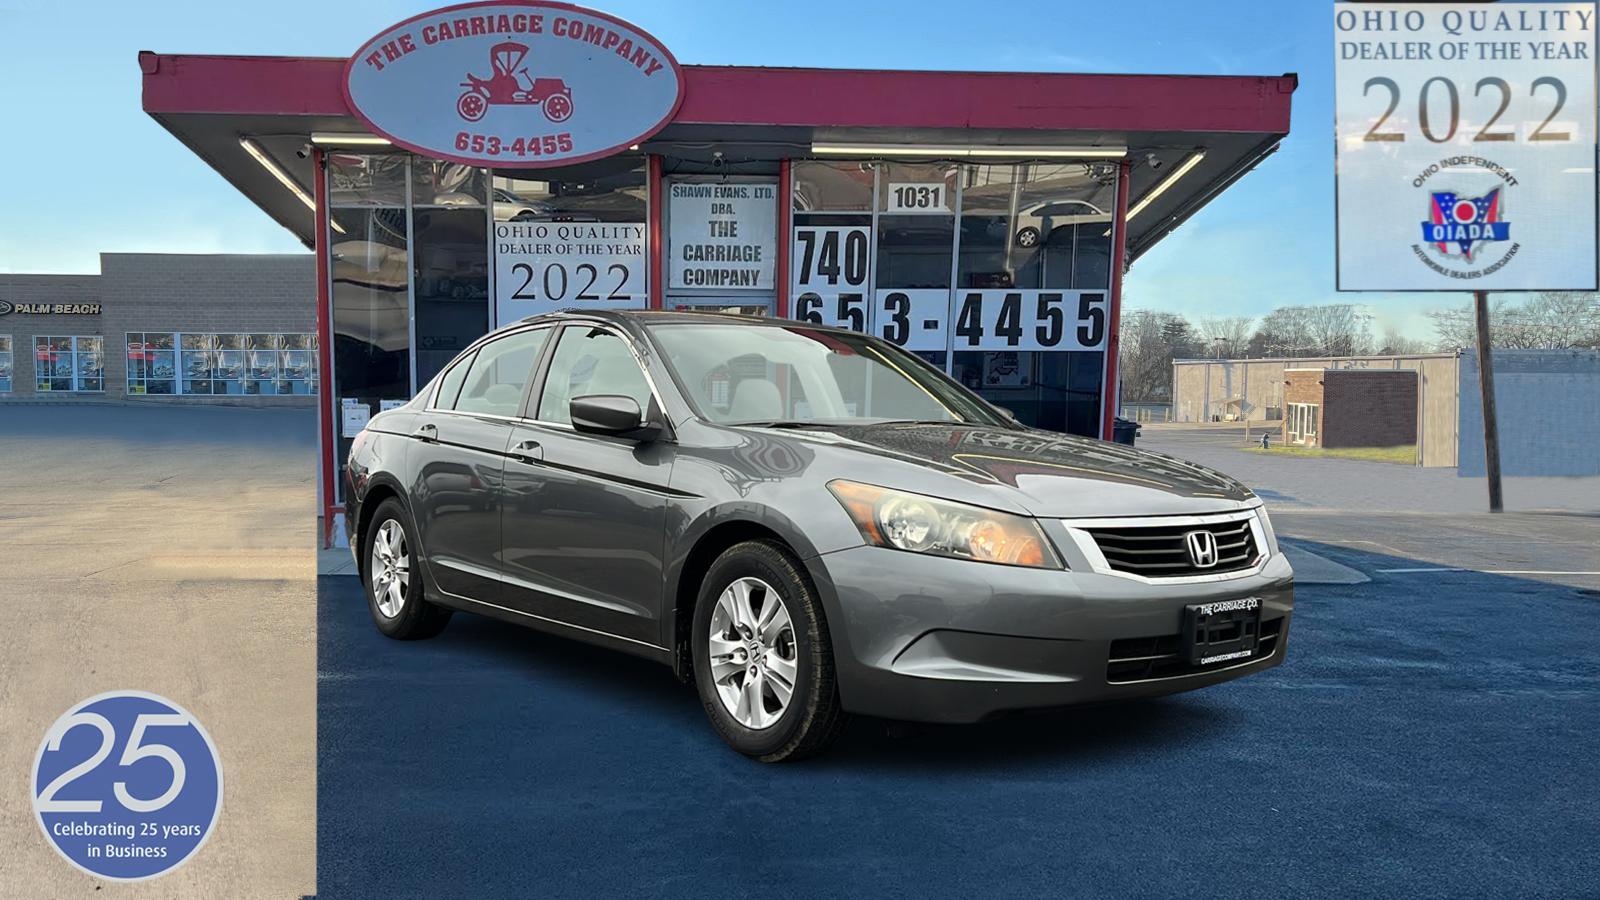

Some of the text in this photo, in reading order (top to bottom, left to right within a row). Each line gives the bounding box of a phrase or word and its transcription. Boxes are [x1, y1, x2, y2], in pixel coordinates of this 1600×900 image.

[1336, 10, 1592, 36] OHIO QUALITY
[365, 14, 664, 77] THE CARRIAGE COMPANY
[1340, 42, 1589, 60] DEALER OF THE YEAR
[1362, 76, 1571, 143] 2022
[454, 132, 573, 156] 653-4455
[1412, 155, 1519, 188] OHIO INDEPENDENT
[672, 187, 712, 199] SHAWN
[754, 187, 774, 199] LTD.
[894, 187, 940, 208] 1031
[711, 203, 736, 215] DBA.
[497, 225, 645, 241] OHIO QUALITY
[708, 220, 738, 238] THE
[1432, 224, 1495, 240] OIADA
[499, 243, 641, 255] DEALER OF THE YEAR
[683, 245, 762, 262] CARRIAGE
[797, 230, 868, 286] 740
[510, 262, 632, 301] 2022
[683, 268, 761, 287] COMPANY
[14, 304, 101, 314] PALM BEACH
[1200, 604, 1213, 616] THE
[1213, 599, 1247, 613] CARRIAGE
